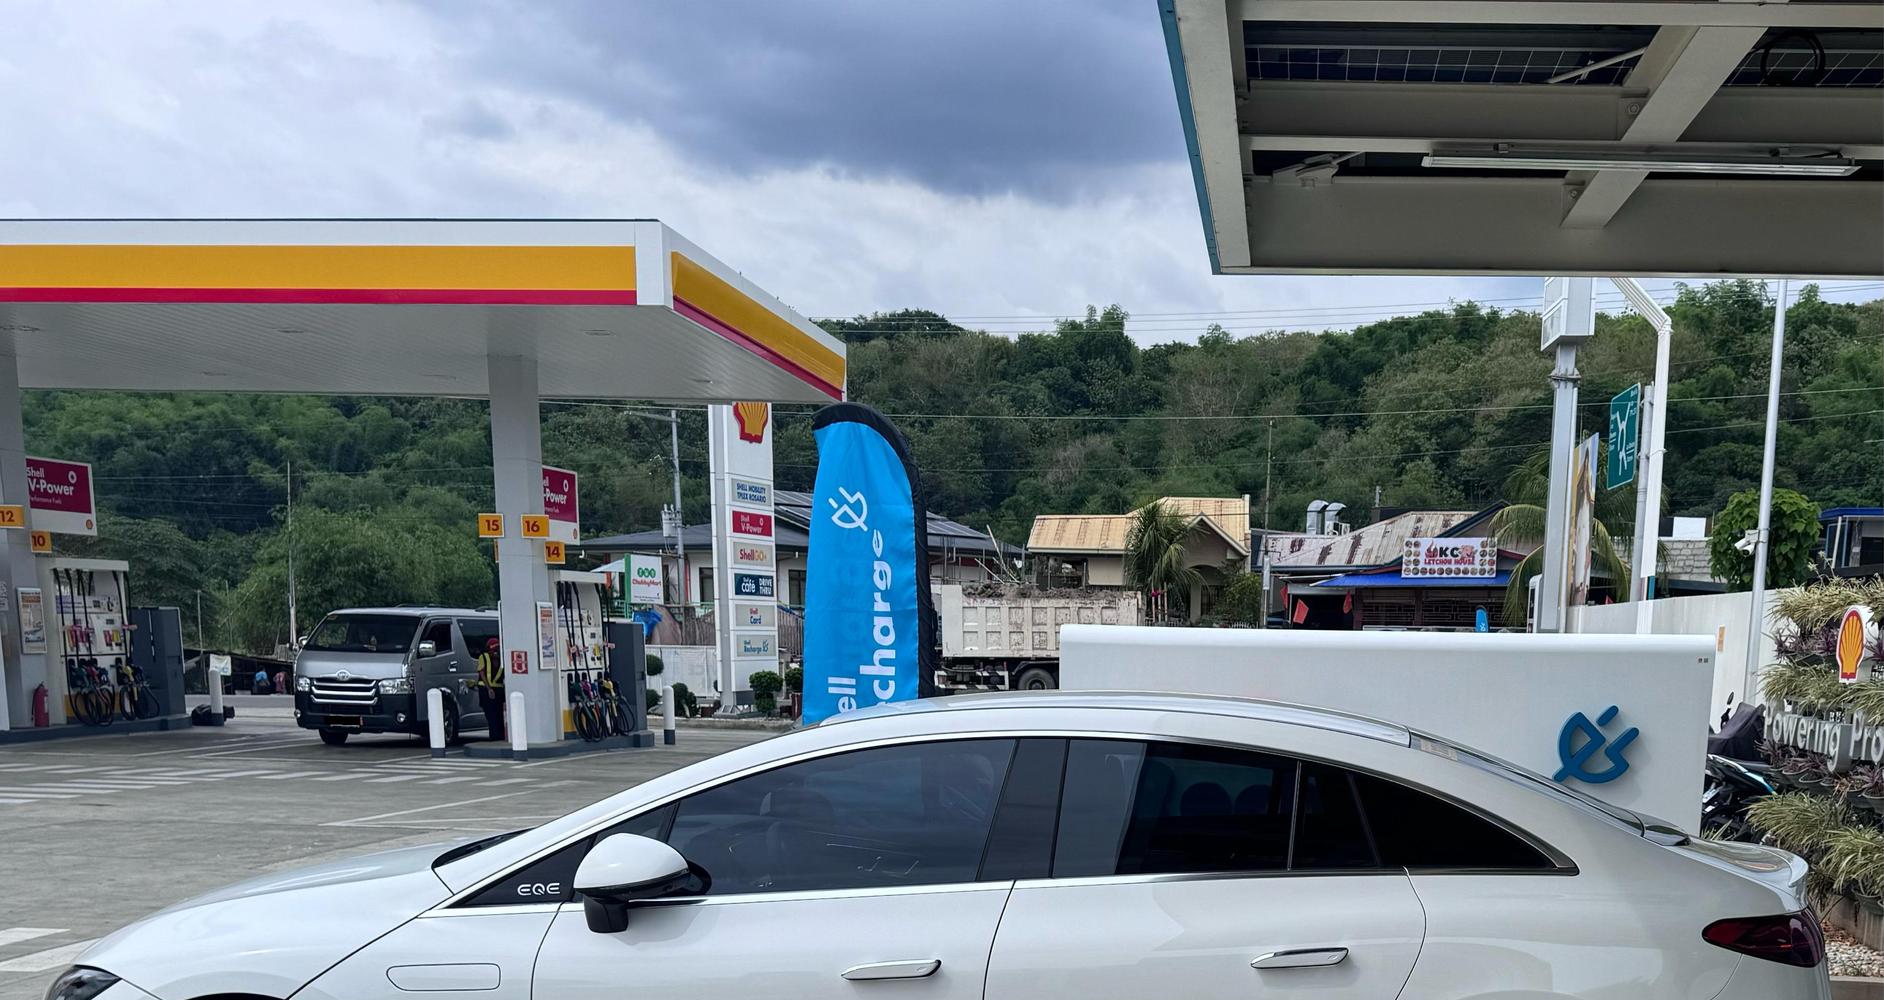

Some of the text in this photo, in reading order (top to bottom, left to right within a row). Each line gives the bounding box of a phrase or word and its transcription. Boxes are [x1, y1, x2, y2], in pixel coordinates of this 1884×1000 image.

[26, 466, 45, 478] Shell
[28, 478, 74, 496] V-Power
[543, 488, 567, 504] -Power
[0, 510, 15, 523] 12
[485, 519, 500, 532] 15
[525, 520, 540, 533] 16
[31, 535, 46, 547] 10
[545, 545, 560, 558] 14
[859, 529, 896, 705] charge
[827, 676, 857, 715] ell
[1763, 699, 1841, 772] Powering
[517, 882, 561, 896] EQE
